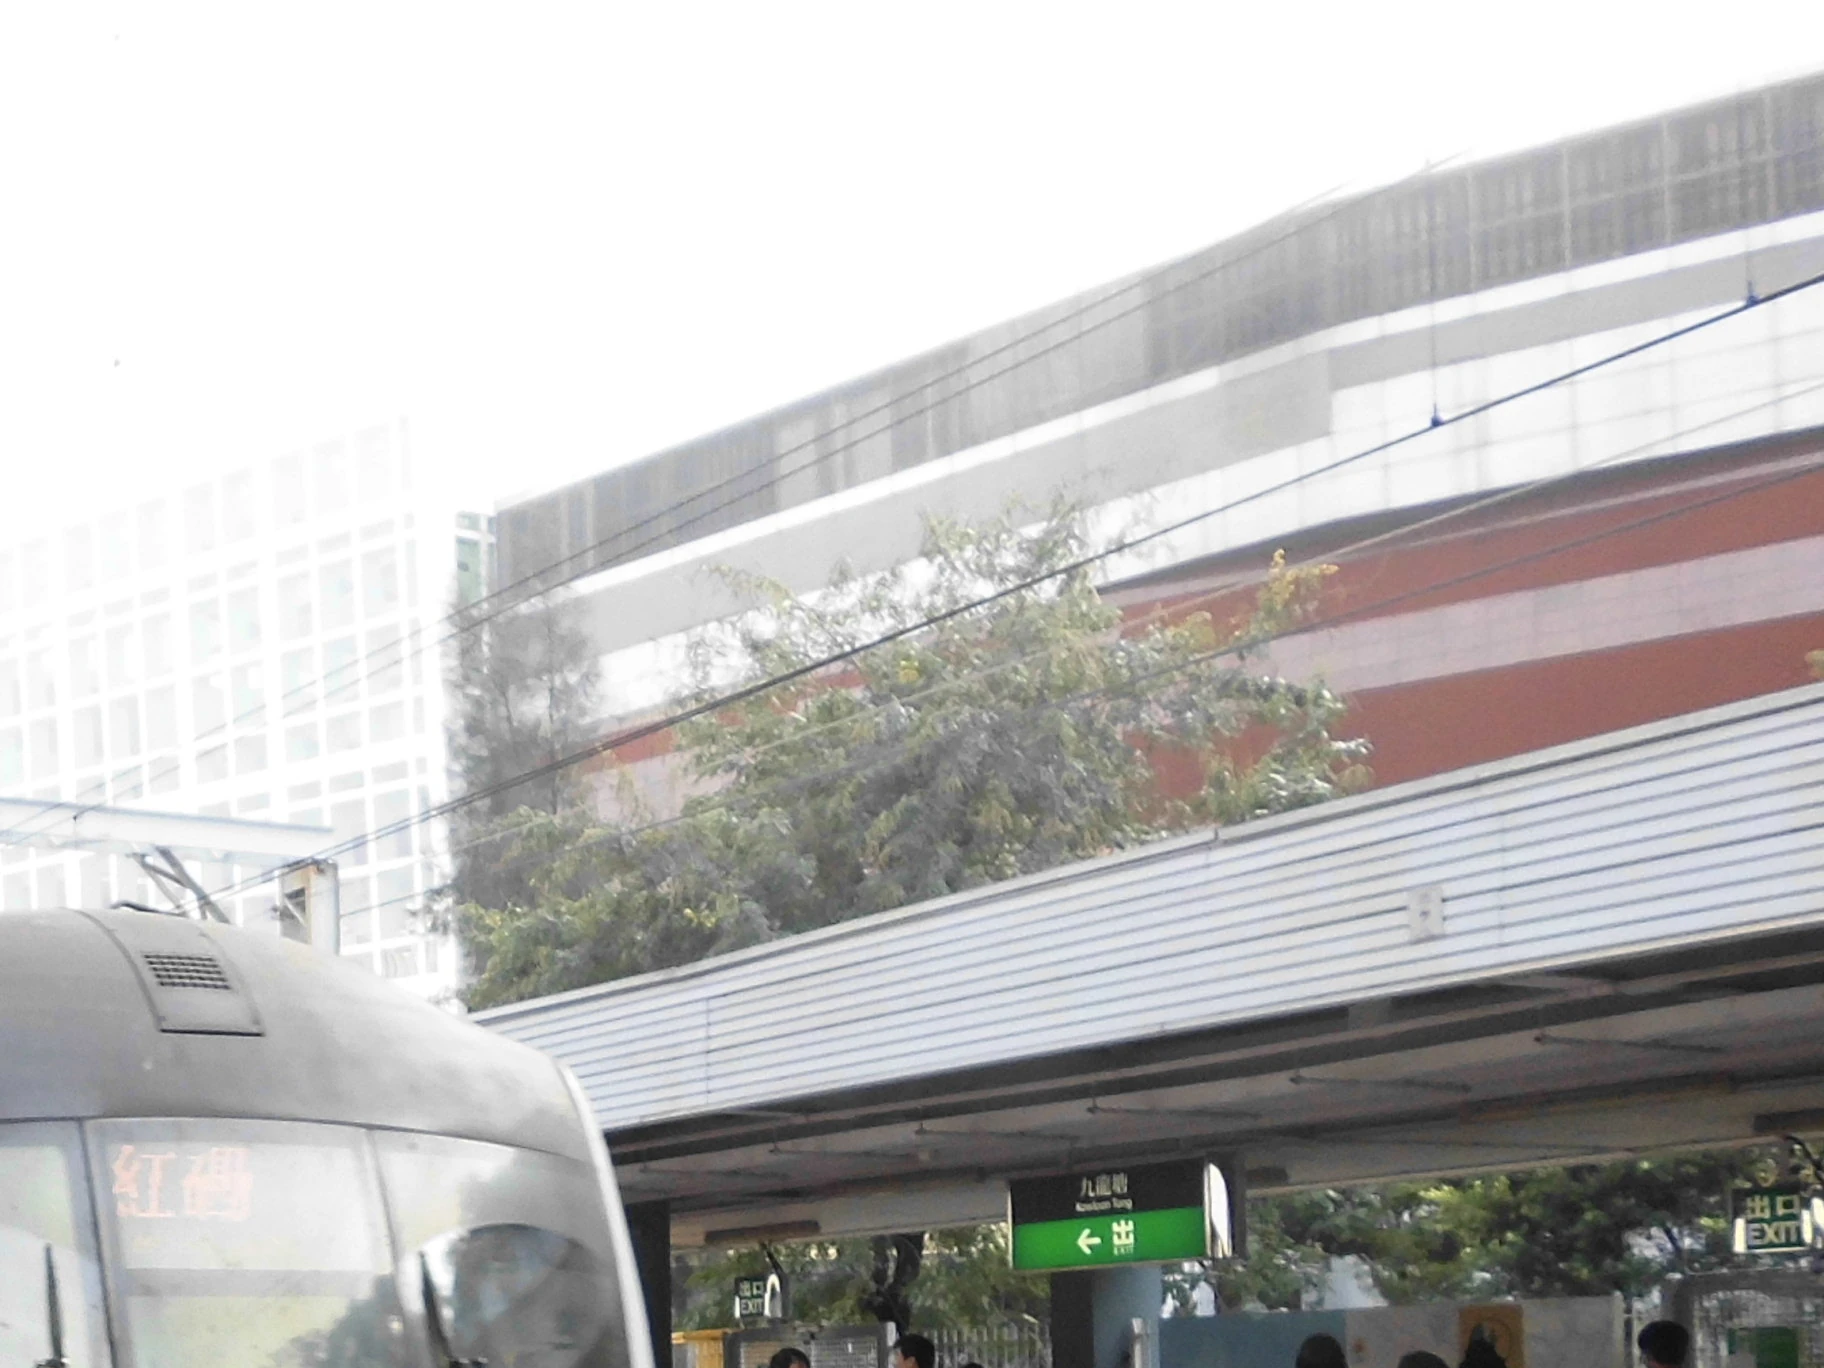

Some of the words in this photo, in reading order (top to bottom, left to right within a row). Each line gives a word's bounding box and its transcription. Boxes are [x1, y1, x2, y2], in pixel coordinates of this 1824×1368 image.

[1746, 1194, 1801, 1220] 出口
[1112, 1219, 1135, 1246] 出
[1747, 1221, 1801, 1246] EXIT
[740, 1298, 764, 1315] EXIT
